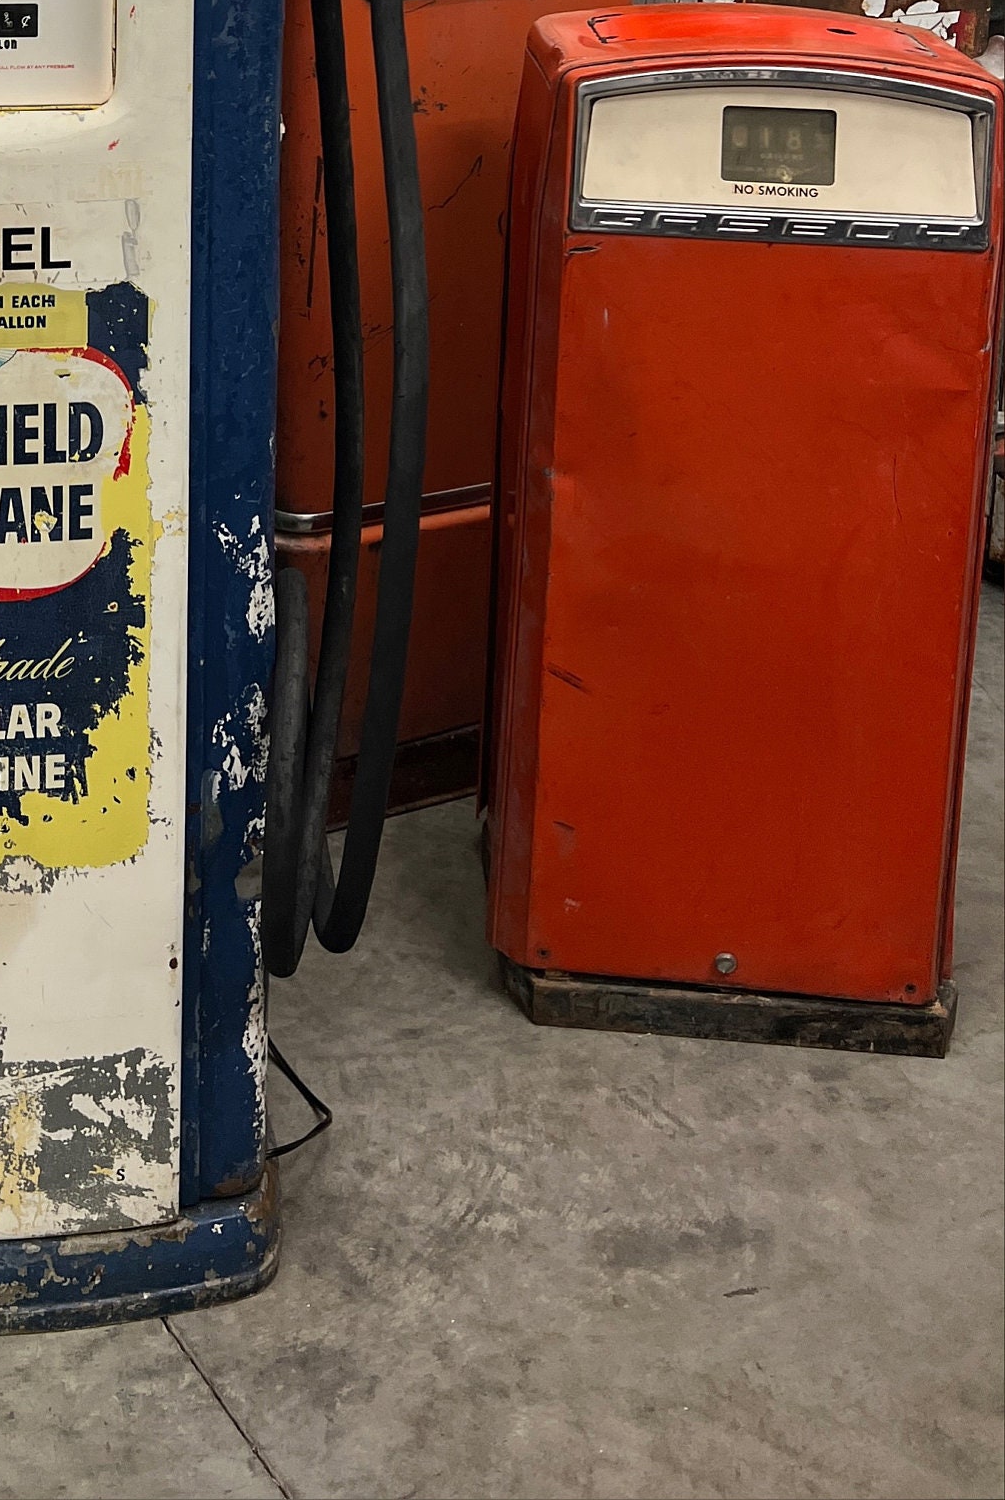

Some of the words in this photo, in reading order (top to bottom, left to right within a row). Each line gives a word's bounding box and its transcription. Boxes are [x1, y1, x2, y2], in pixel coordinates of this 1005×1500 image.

[734, 184, 753, 195] NO
[758, 185, 819, 198] SMOKING
[12, 294, 56, 309] EACH
